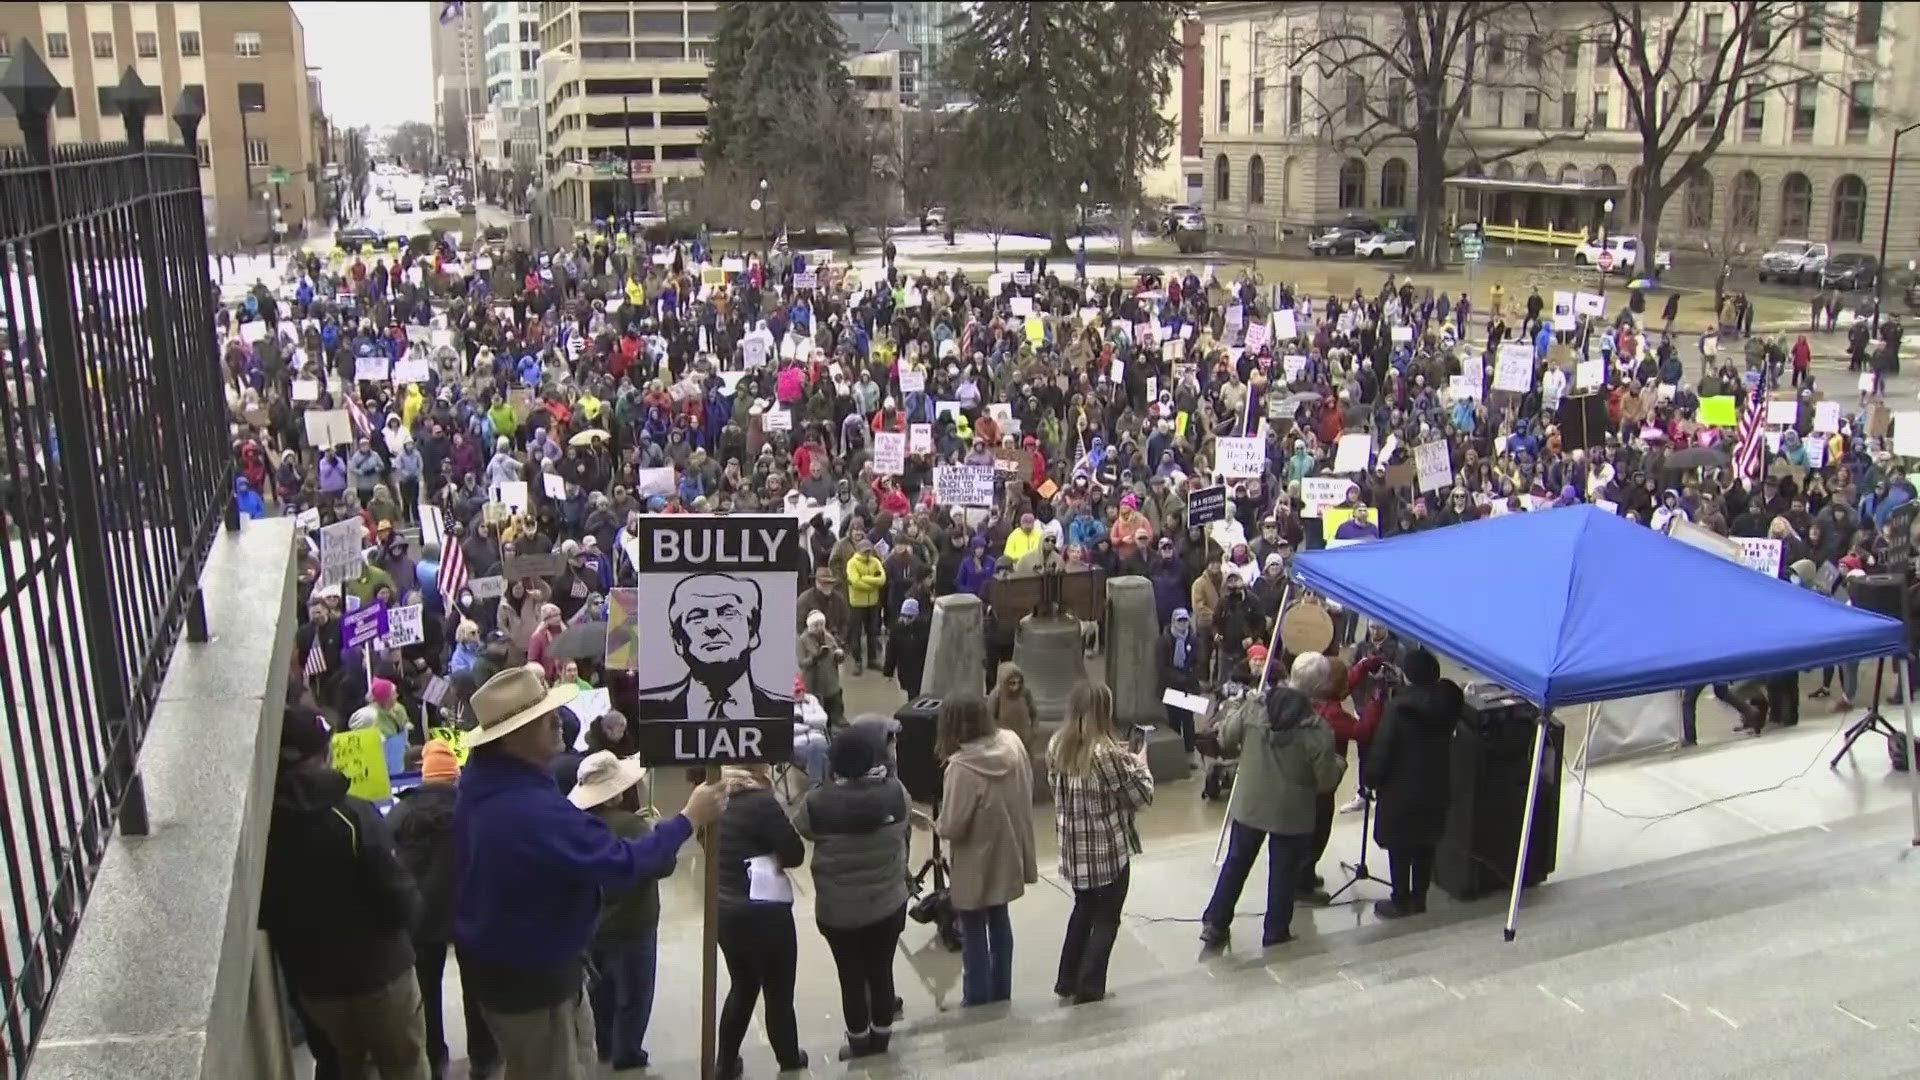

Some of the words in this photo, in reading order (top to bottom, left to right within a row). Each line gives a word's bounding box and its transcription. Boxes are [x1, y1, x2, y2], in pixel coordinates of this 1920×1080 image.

[940, 495, 984, 503] PRESIDENT
[653, 528, 788, 564] BULLY
[674, 727, 763, 761] LIAR
